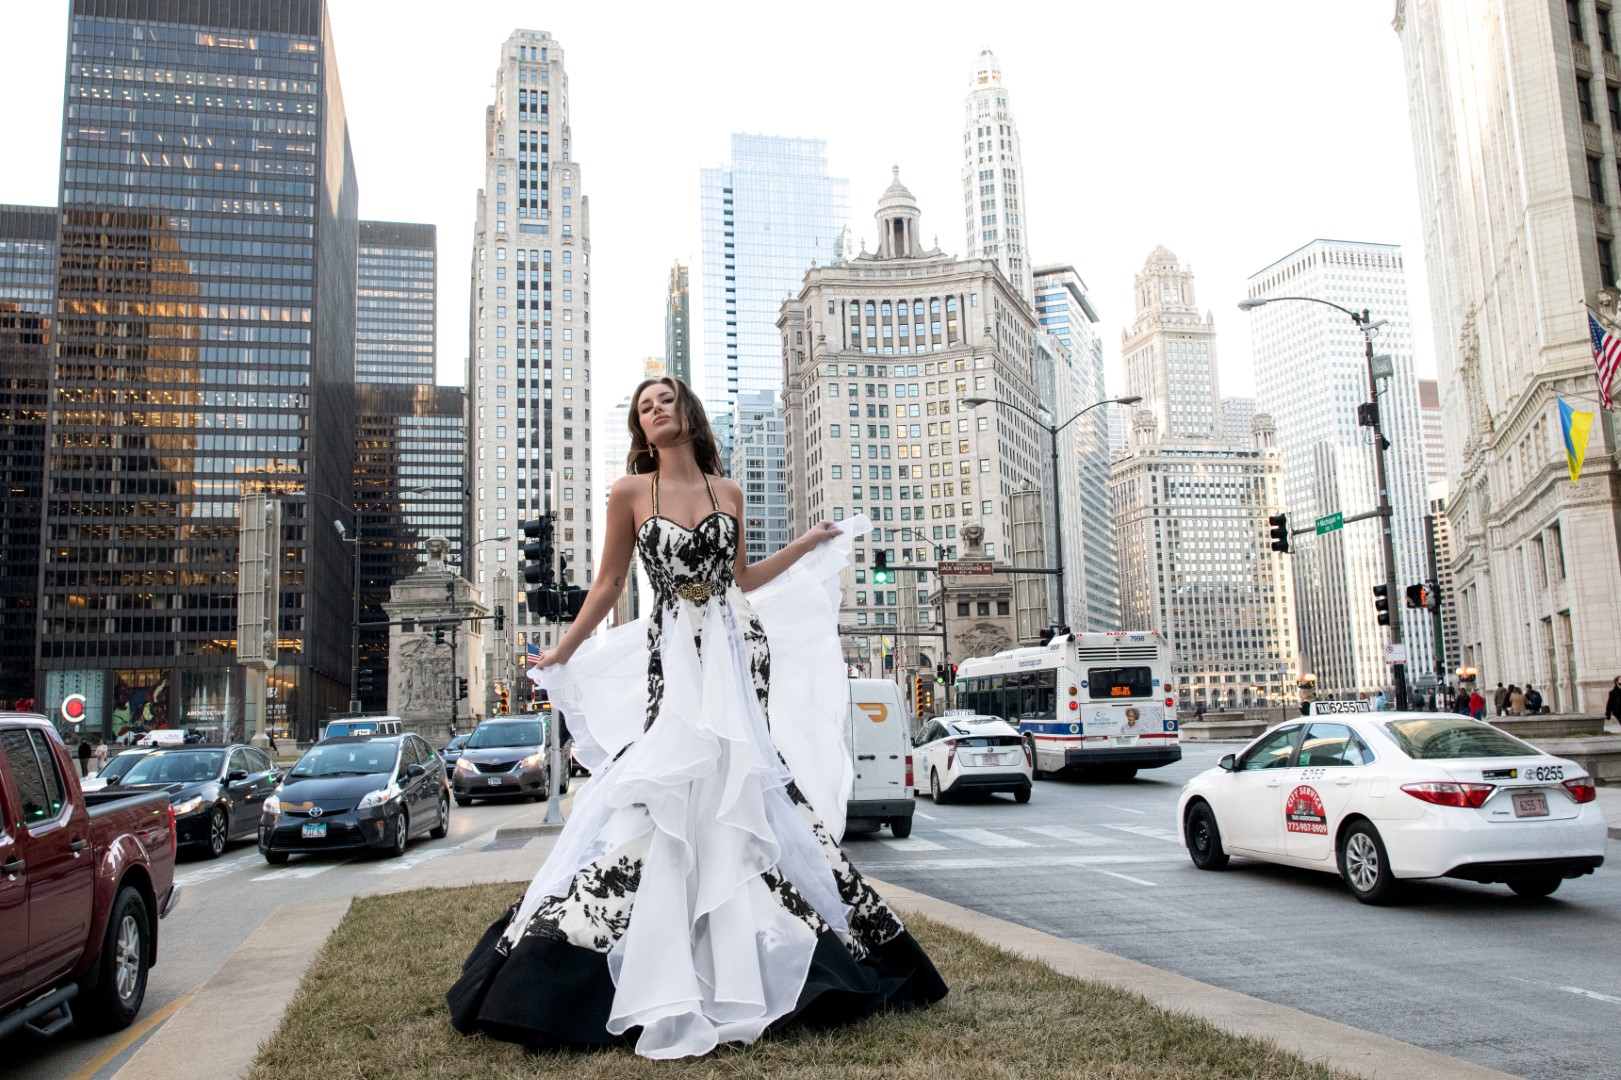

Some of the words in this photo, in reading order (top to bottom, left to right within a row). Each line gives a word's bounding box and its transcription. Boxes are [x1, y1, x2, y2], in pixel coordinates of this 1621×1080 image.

[1320, 516, 1336, 527] Michigan
[1330, 701, 1356, 714] 6255
[1301, 769, 1326, 780] 6255
[1536, 765, 1564, 781] 6255
[1287, 789, 1299, 808] CITY
[1299, 786, 1323, 810] SERVICE
[1520, 799, 1537, 811] 6255
[1287, 822, 1328, 833] 773-907-0909
